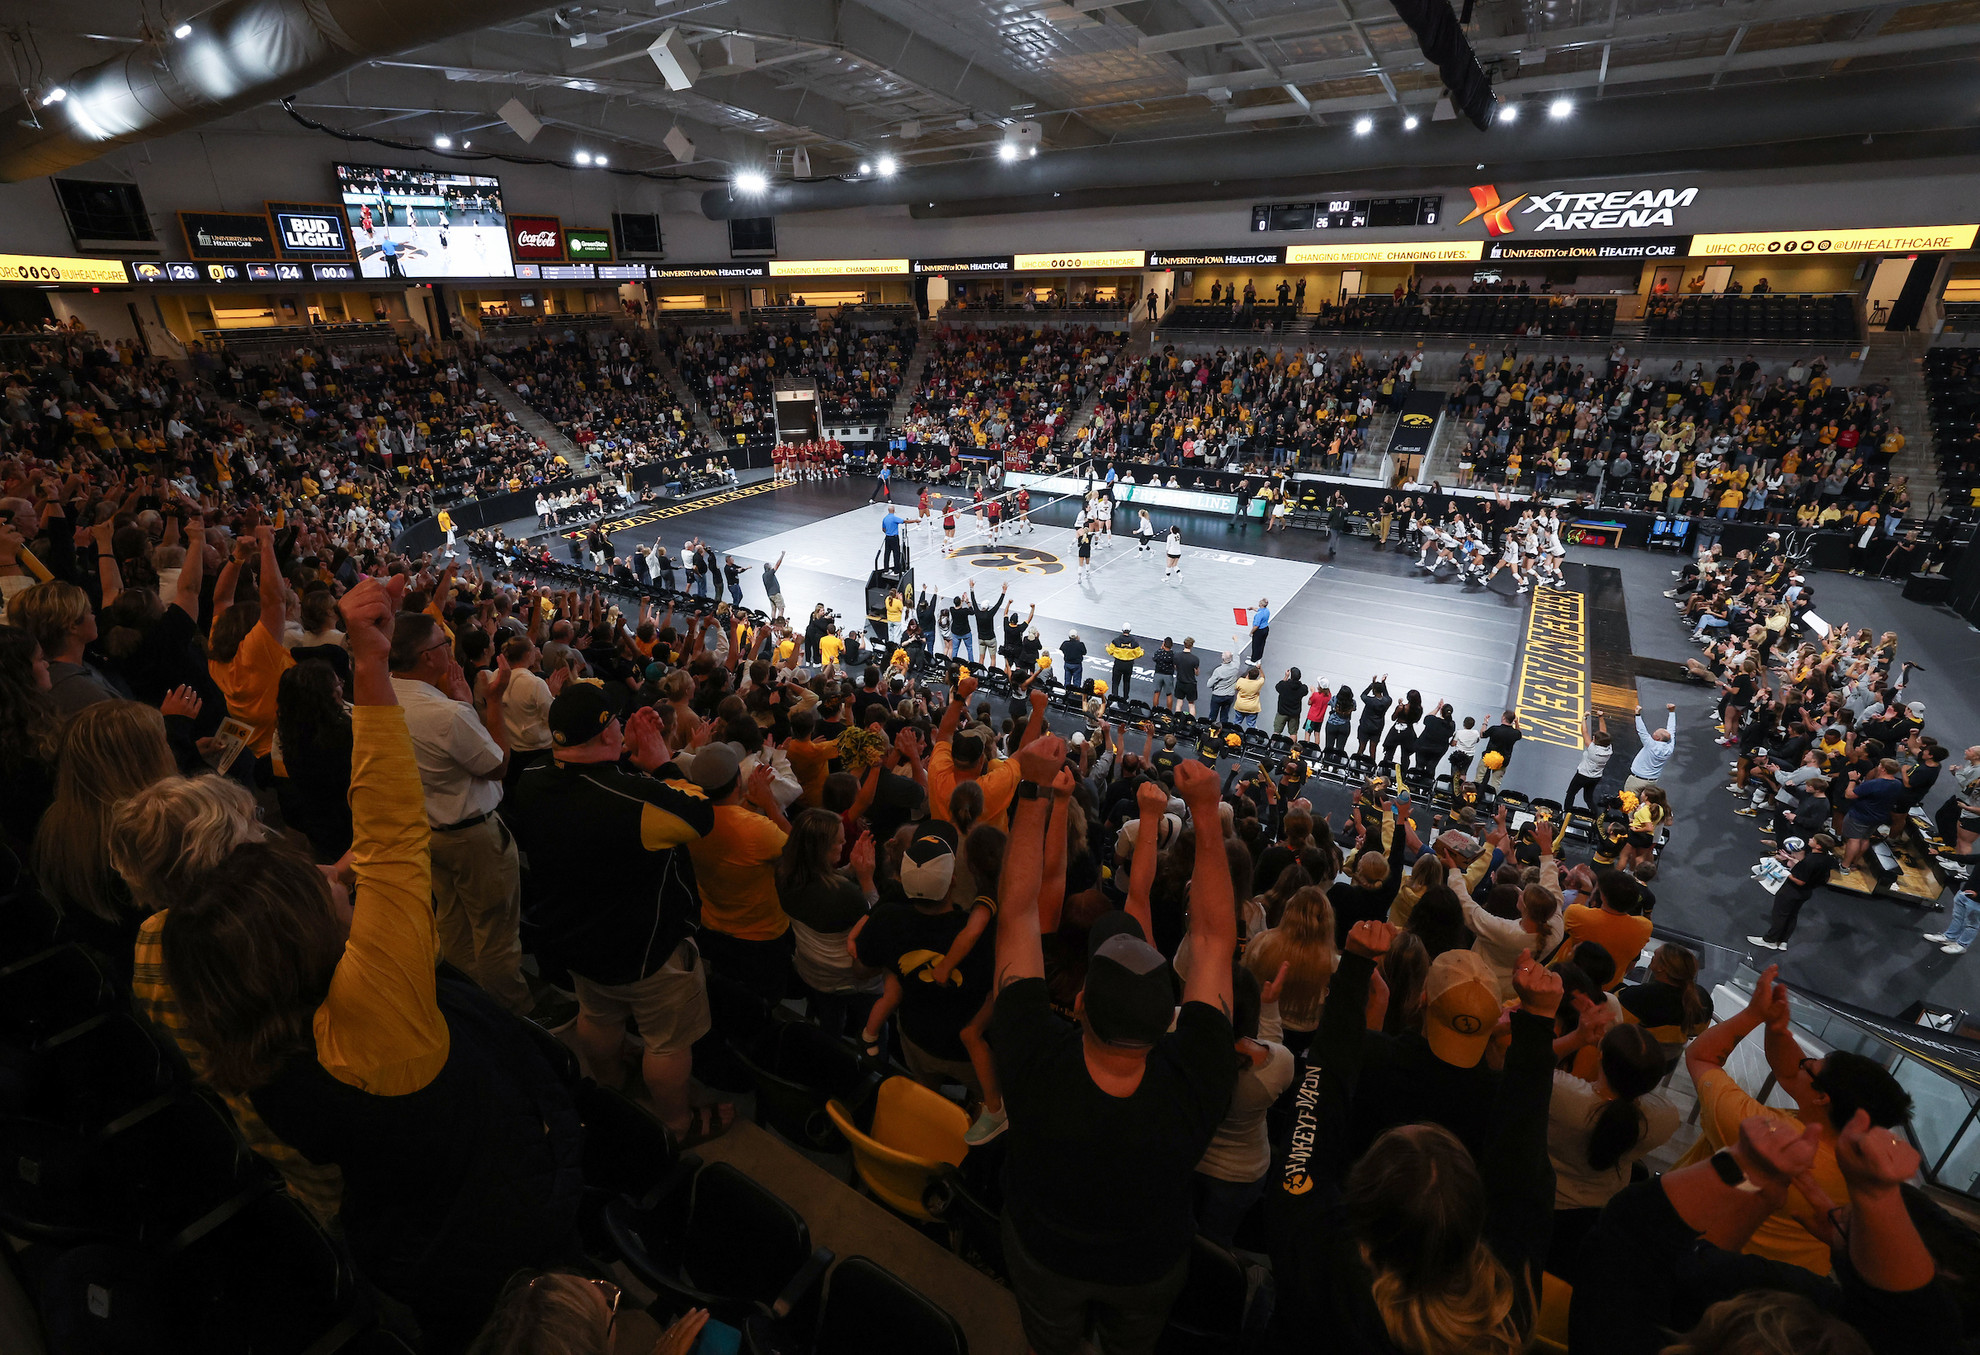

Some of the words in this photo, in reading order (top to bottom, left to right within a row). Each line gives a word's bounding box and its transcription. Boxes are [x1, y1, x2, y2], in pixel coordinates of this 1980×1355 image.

[1521, 187, 1699, 214] XTREAM
[1316, 218, 1328, 228] 26
[1351, 216, 1365, 227] 24
[1427, 213, 1435, 224] 0
[1533, 208, 1674, 232] ARENA
[290, 218, 330, 233] BUD
[1259, 220, 1266, 231] 0
[518, 230, 556, 248] Coca-Cola
[1705, 243, 1765, 254] UIHC.ORG
[1833, 236, 1954, 251] @UIHEALTHCARE
[1295, 253, 1340, 262] CHANGING
[1387, 251, 1436, 260] CHANGING
[1502, 248, 1558, 258] UNIVERSITY
[1568, 247, 1597, 257] IOWA
[1599, 246, 1644, 257] HEALTH
[1644, 245, 1676, 256] CARE
[1158, 257, 1197, 265] UNIVERSITY
[1204, 256, 1224, 264] IOWA
[1225, 255, 1255, 264] HEALTH
[1256, 254, 1277, 263] CARE
[173, 266, 195, 280] 26
[213, 268, 220, 278] 0
[228, 267, 235, 278] 0
[281, 266, 299, 279] 24
[321, 267, 347, 279] 00.0
[745, 268, 762, 276] CARE
[921, 264, 950, 272] UNIVERSITY
[993, 262, 1008, 270] CARE
[1196, 495, 1231, 510] LINE
[1513, 653, 1585, 751] ARENA
